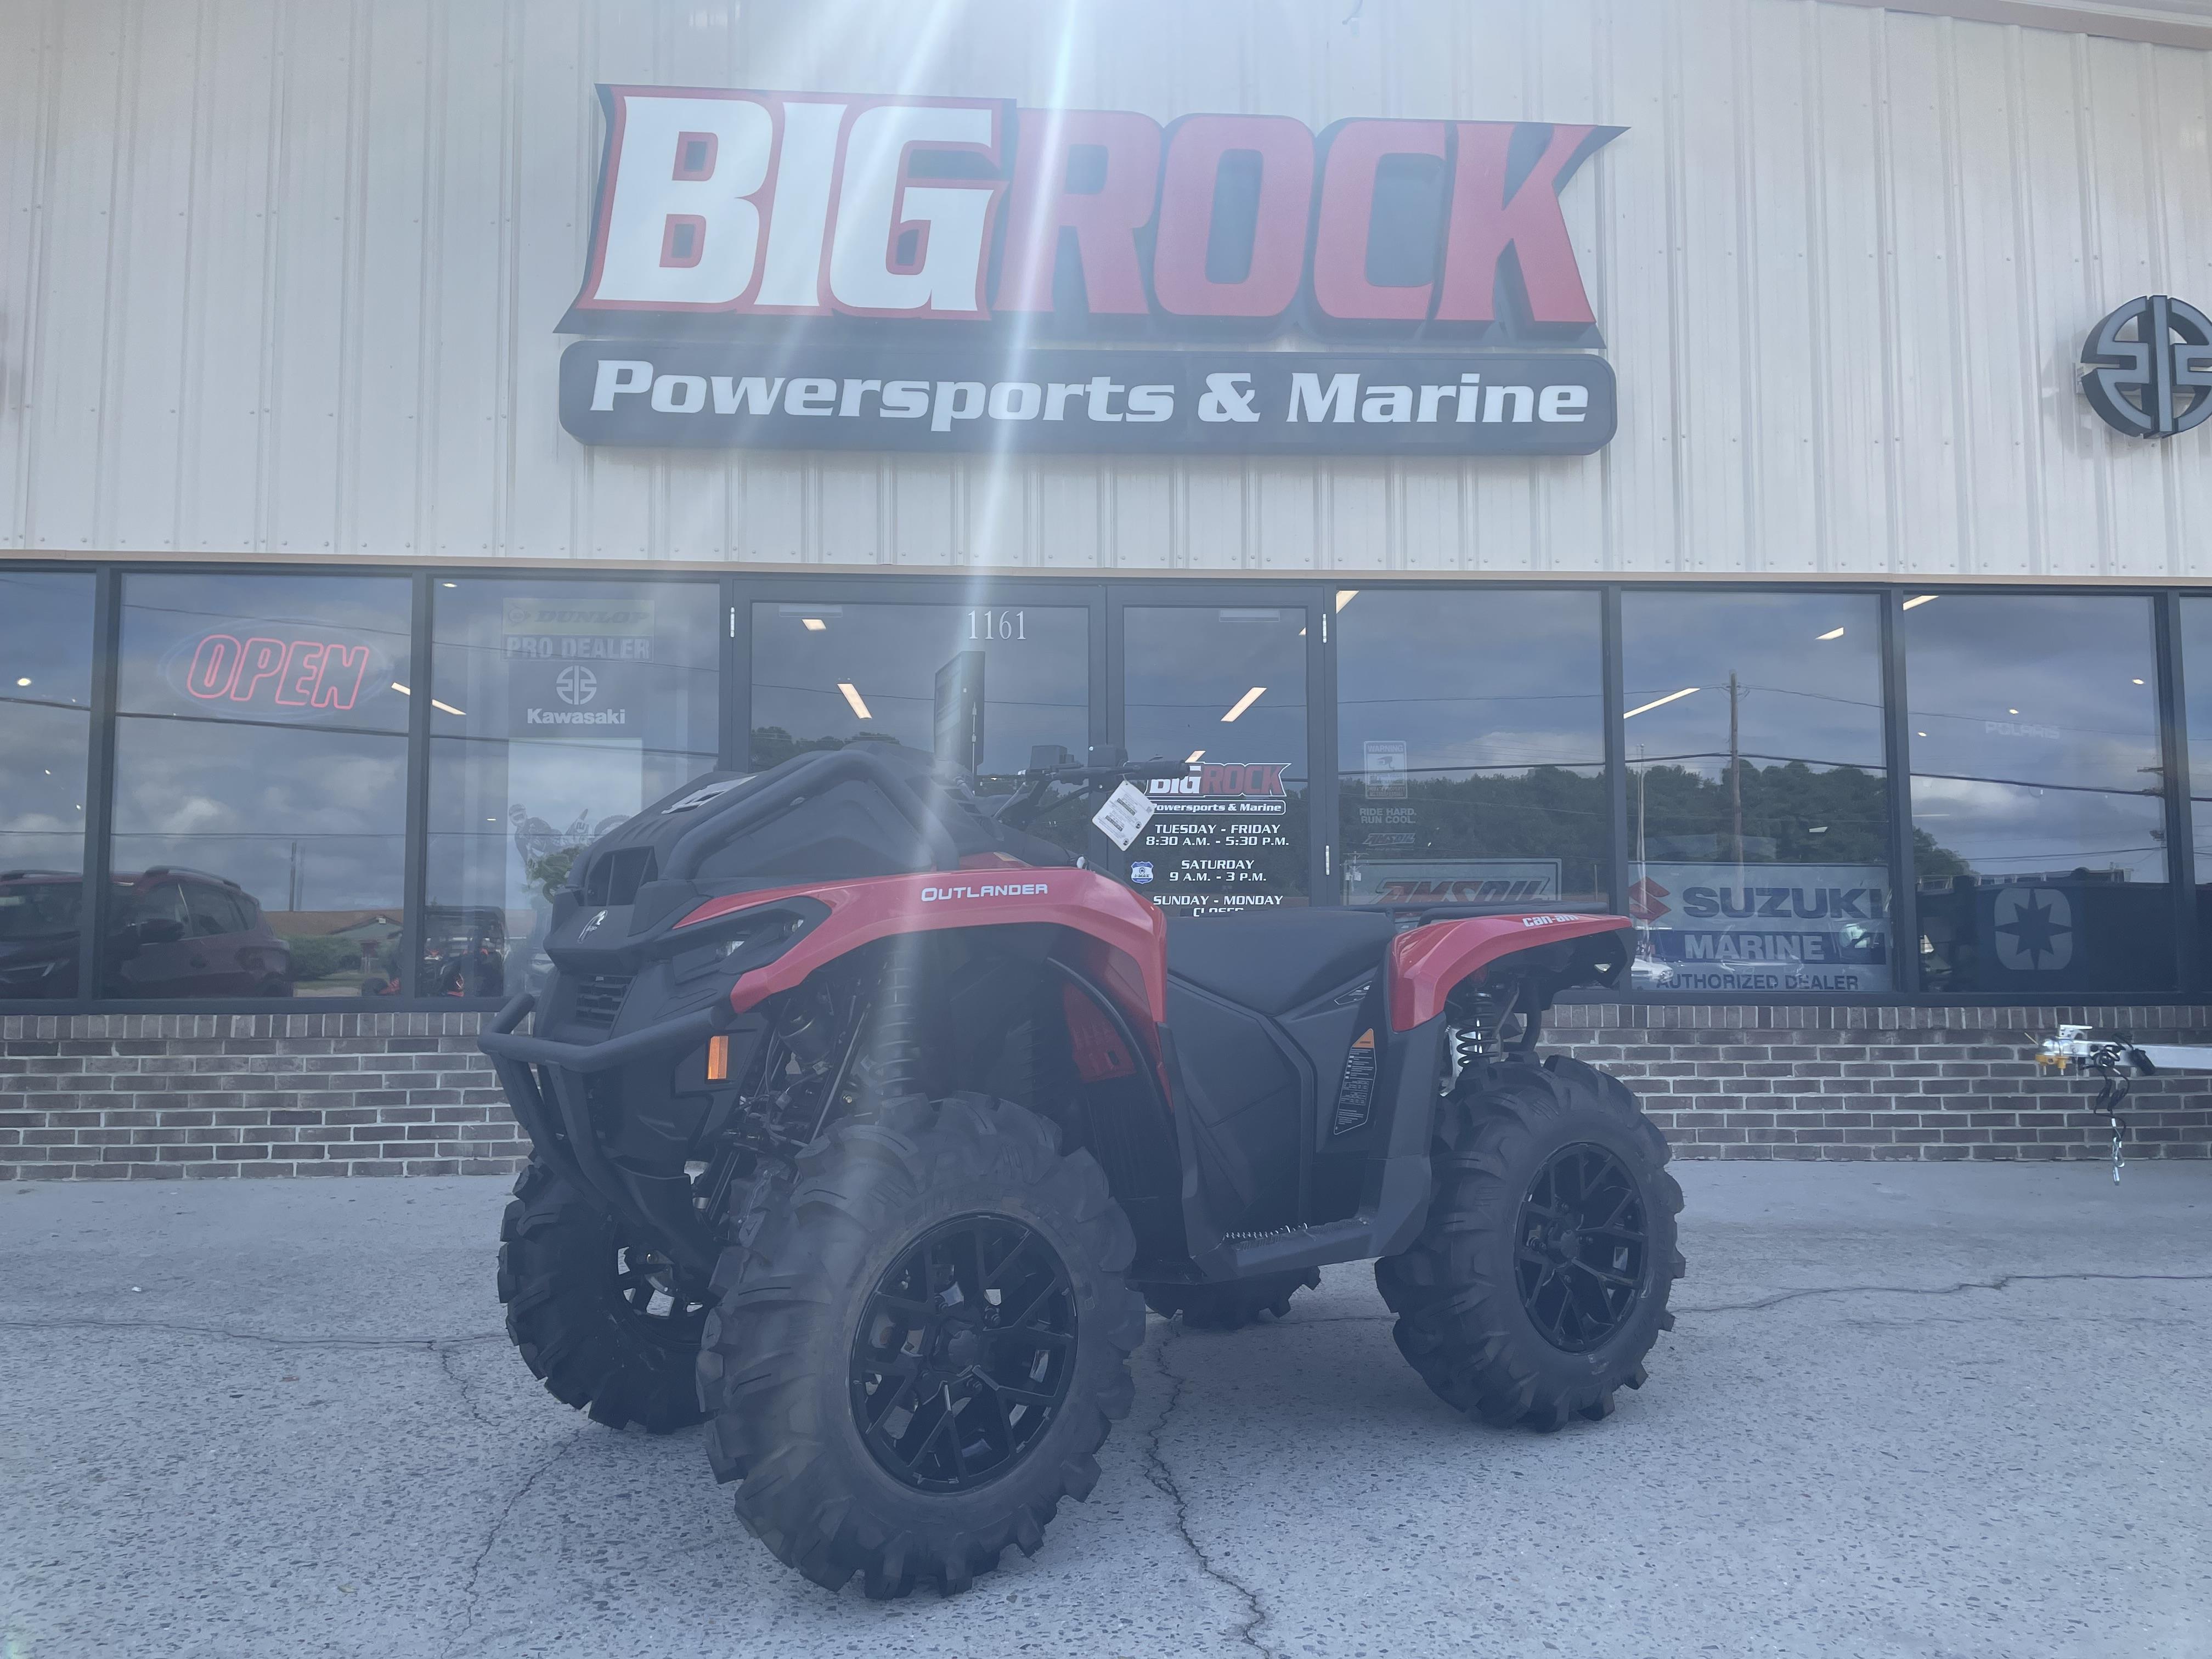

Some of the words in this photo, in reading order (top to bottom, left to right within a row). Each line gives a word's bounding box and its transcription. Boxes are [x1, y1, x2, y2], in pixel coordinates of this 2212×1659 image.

[589, 360, 1175, 432] Powersports
[1197, 373, 1261, 423] &
[1285, 373, 1589, 423] Marine
[534, 611, 650, 623] DUNLOP
[968, 610, 1026, 640] 1161
[506, 637, 553, 658] PRO
[561, 637, 650, 659] DEALER
[187, 634, 370, 710] OPEN
[527, 708, 625, 724] Kawasaki
[1985, 721, 2060, 740] POLARIS
[1228, 803, 1237, 811] &
[1240, 803, 1282, 811] Marine
[1155, 824, 1217, 834] TUESDAY
[1231, 824, 1281, 834] FRIDAY
[1146, 836, 1178, 845] 8:30
[1182, 837, 1210, 845] A.M.
[1225, 836, 1257, 845] 5:30
[1262, 837, 1289, 845] P.M.
[1181, 860, 1255, 870] SATURDAY
[1169, 872, 1179, 881] 9
[1183, 873, 1211, 881] A.M.
[1226, 872, 1235, 881] 3
[1239, 873, 1267, 881] P.M.
[921, 884, 1048, 902] OUTLANDER
[1374, 879, 1549, 903] AMSOIL
[1153, 895, 1210, 905] SUNDAY
[1223, 895, 1284, 905] MONDAY
[1683, 887, 1884, 919] SUZUKI
[1522, 915, 1579, 927] can-am
[1685, 934, 1825, 961] MARINE
[1656, 974, 1779, 989] AUTHORIZED
[1785, 975, 1859, 990] DEALER
